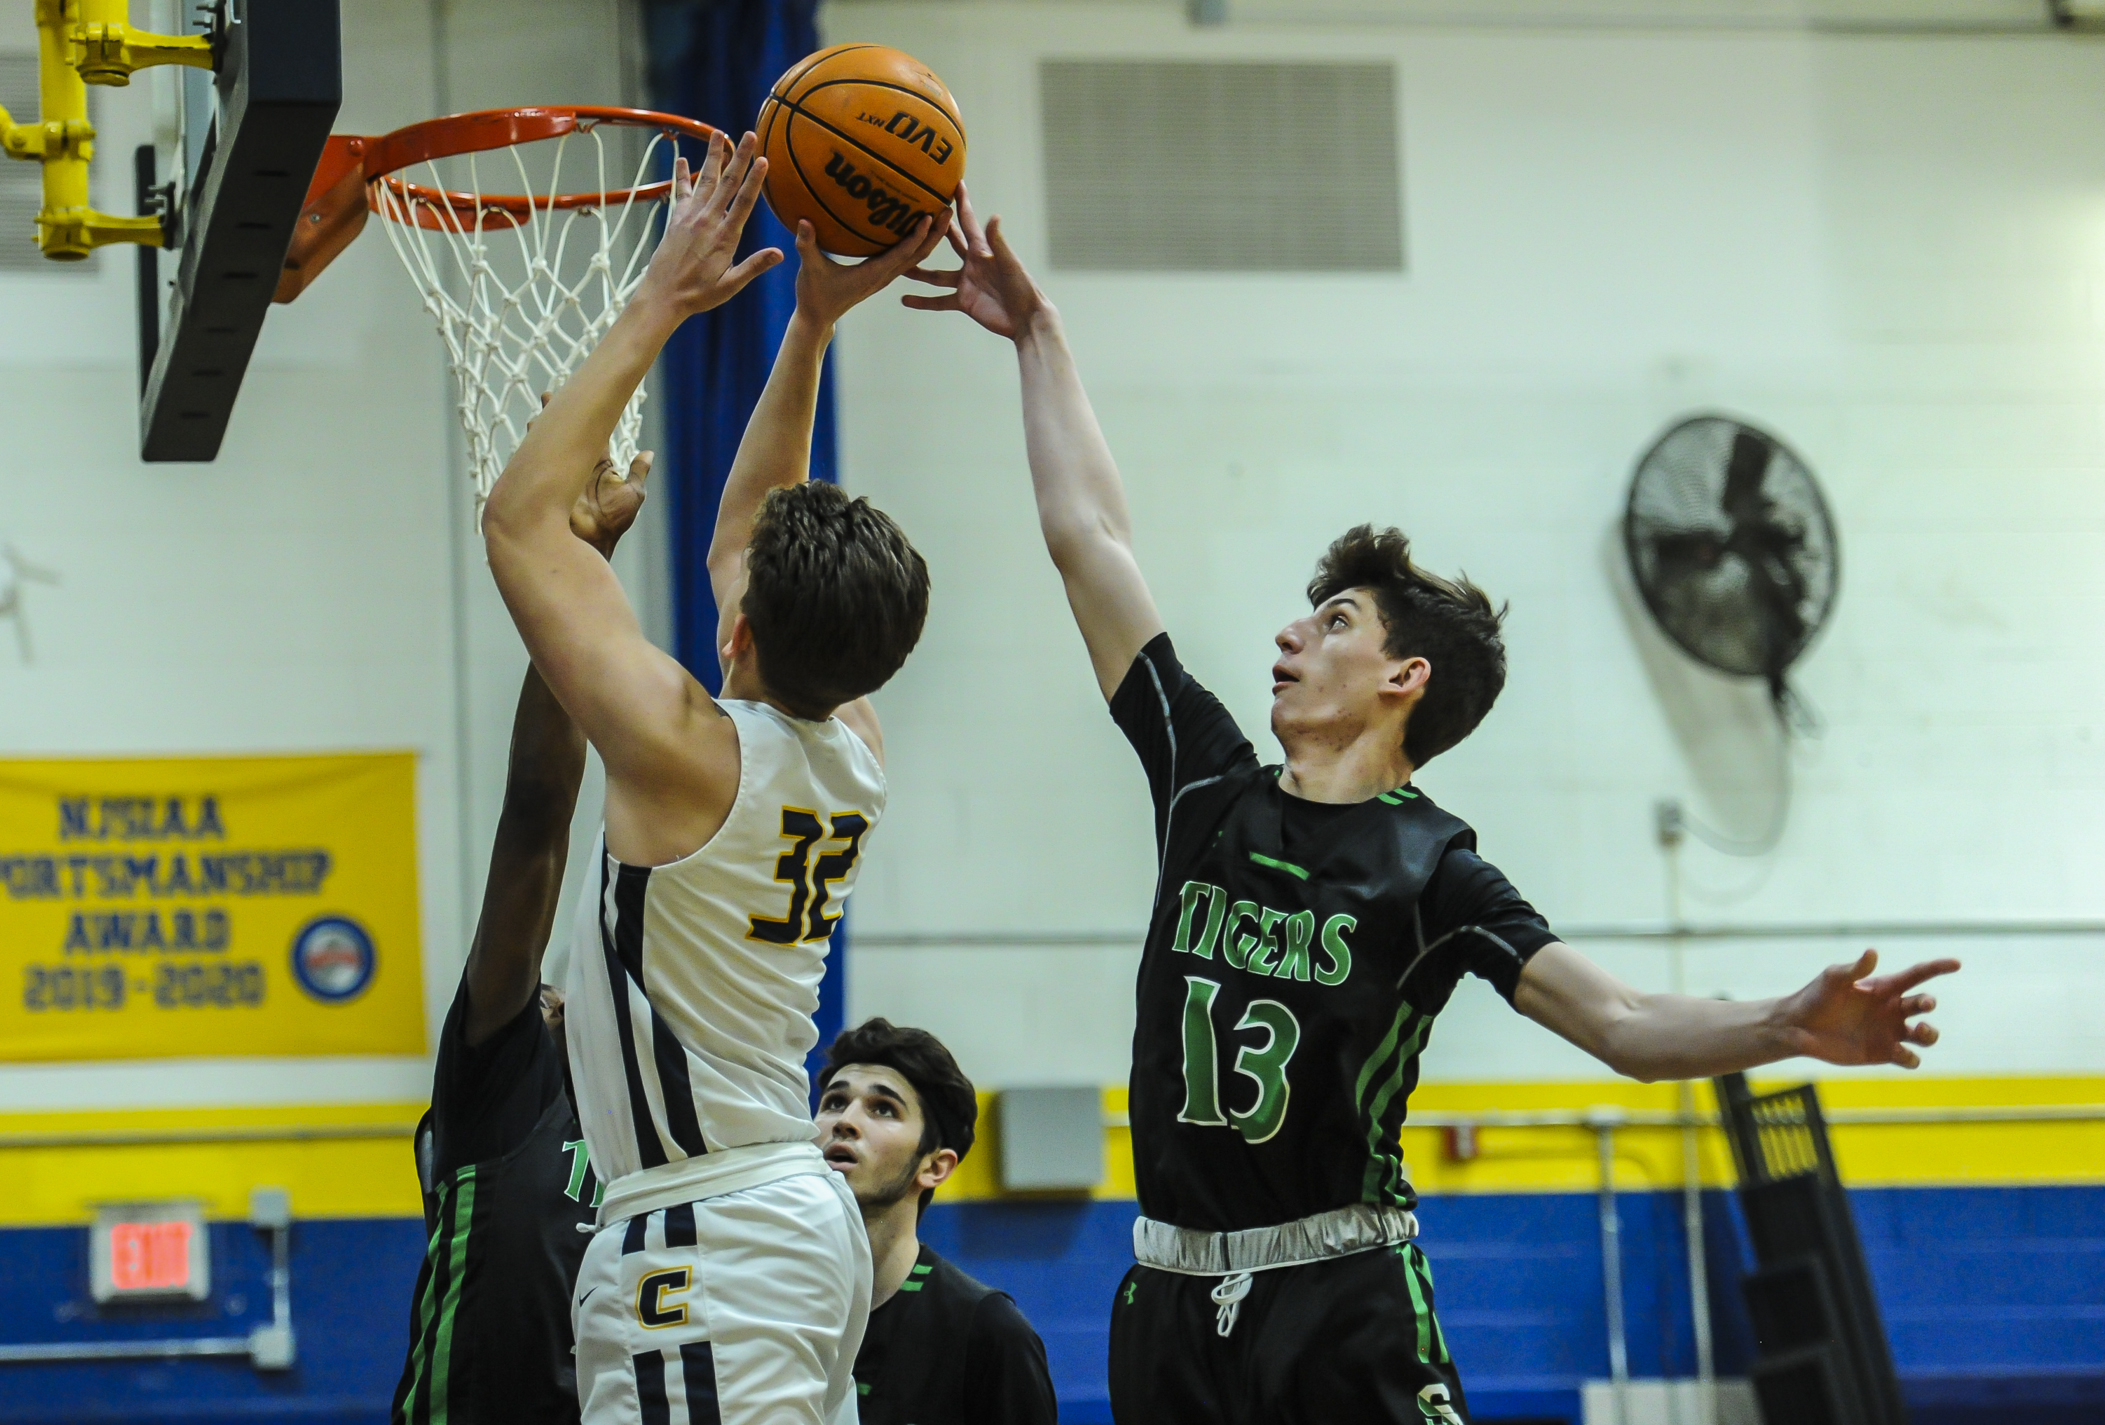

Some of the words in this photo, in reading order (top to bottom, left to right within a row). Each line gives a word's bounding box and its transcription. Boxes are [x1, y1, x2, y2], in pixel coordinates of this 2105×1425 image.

[855, 111, 885, 128] NXT
[884, 110, 953, 165] EVO
[744, 804, 872, 948] 32
[63, 908, 231, 953] AWARD
[1172, 880, 1357, 986] TIGERS
[1177, 975, 1300, 1145] 13
[635, 1265, 692, 1330] C
